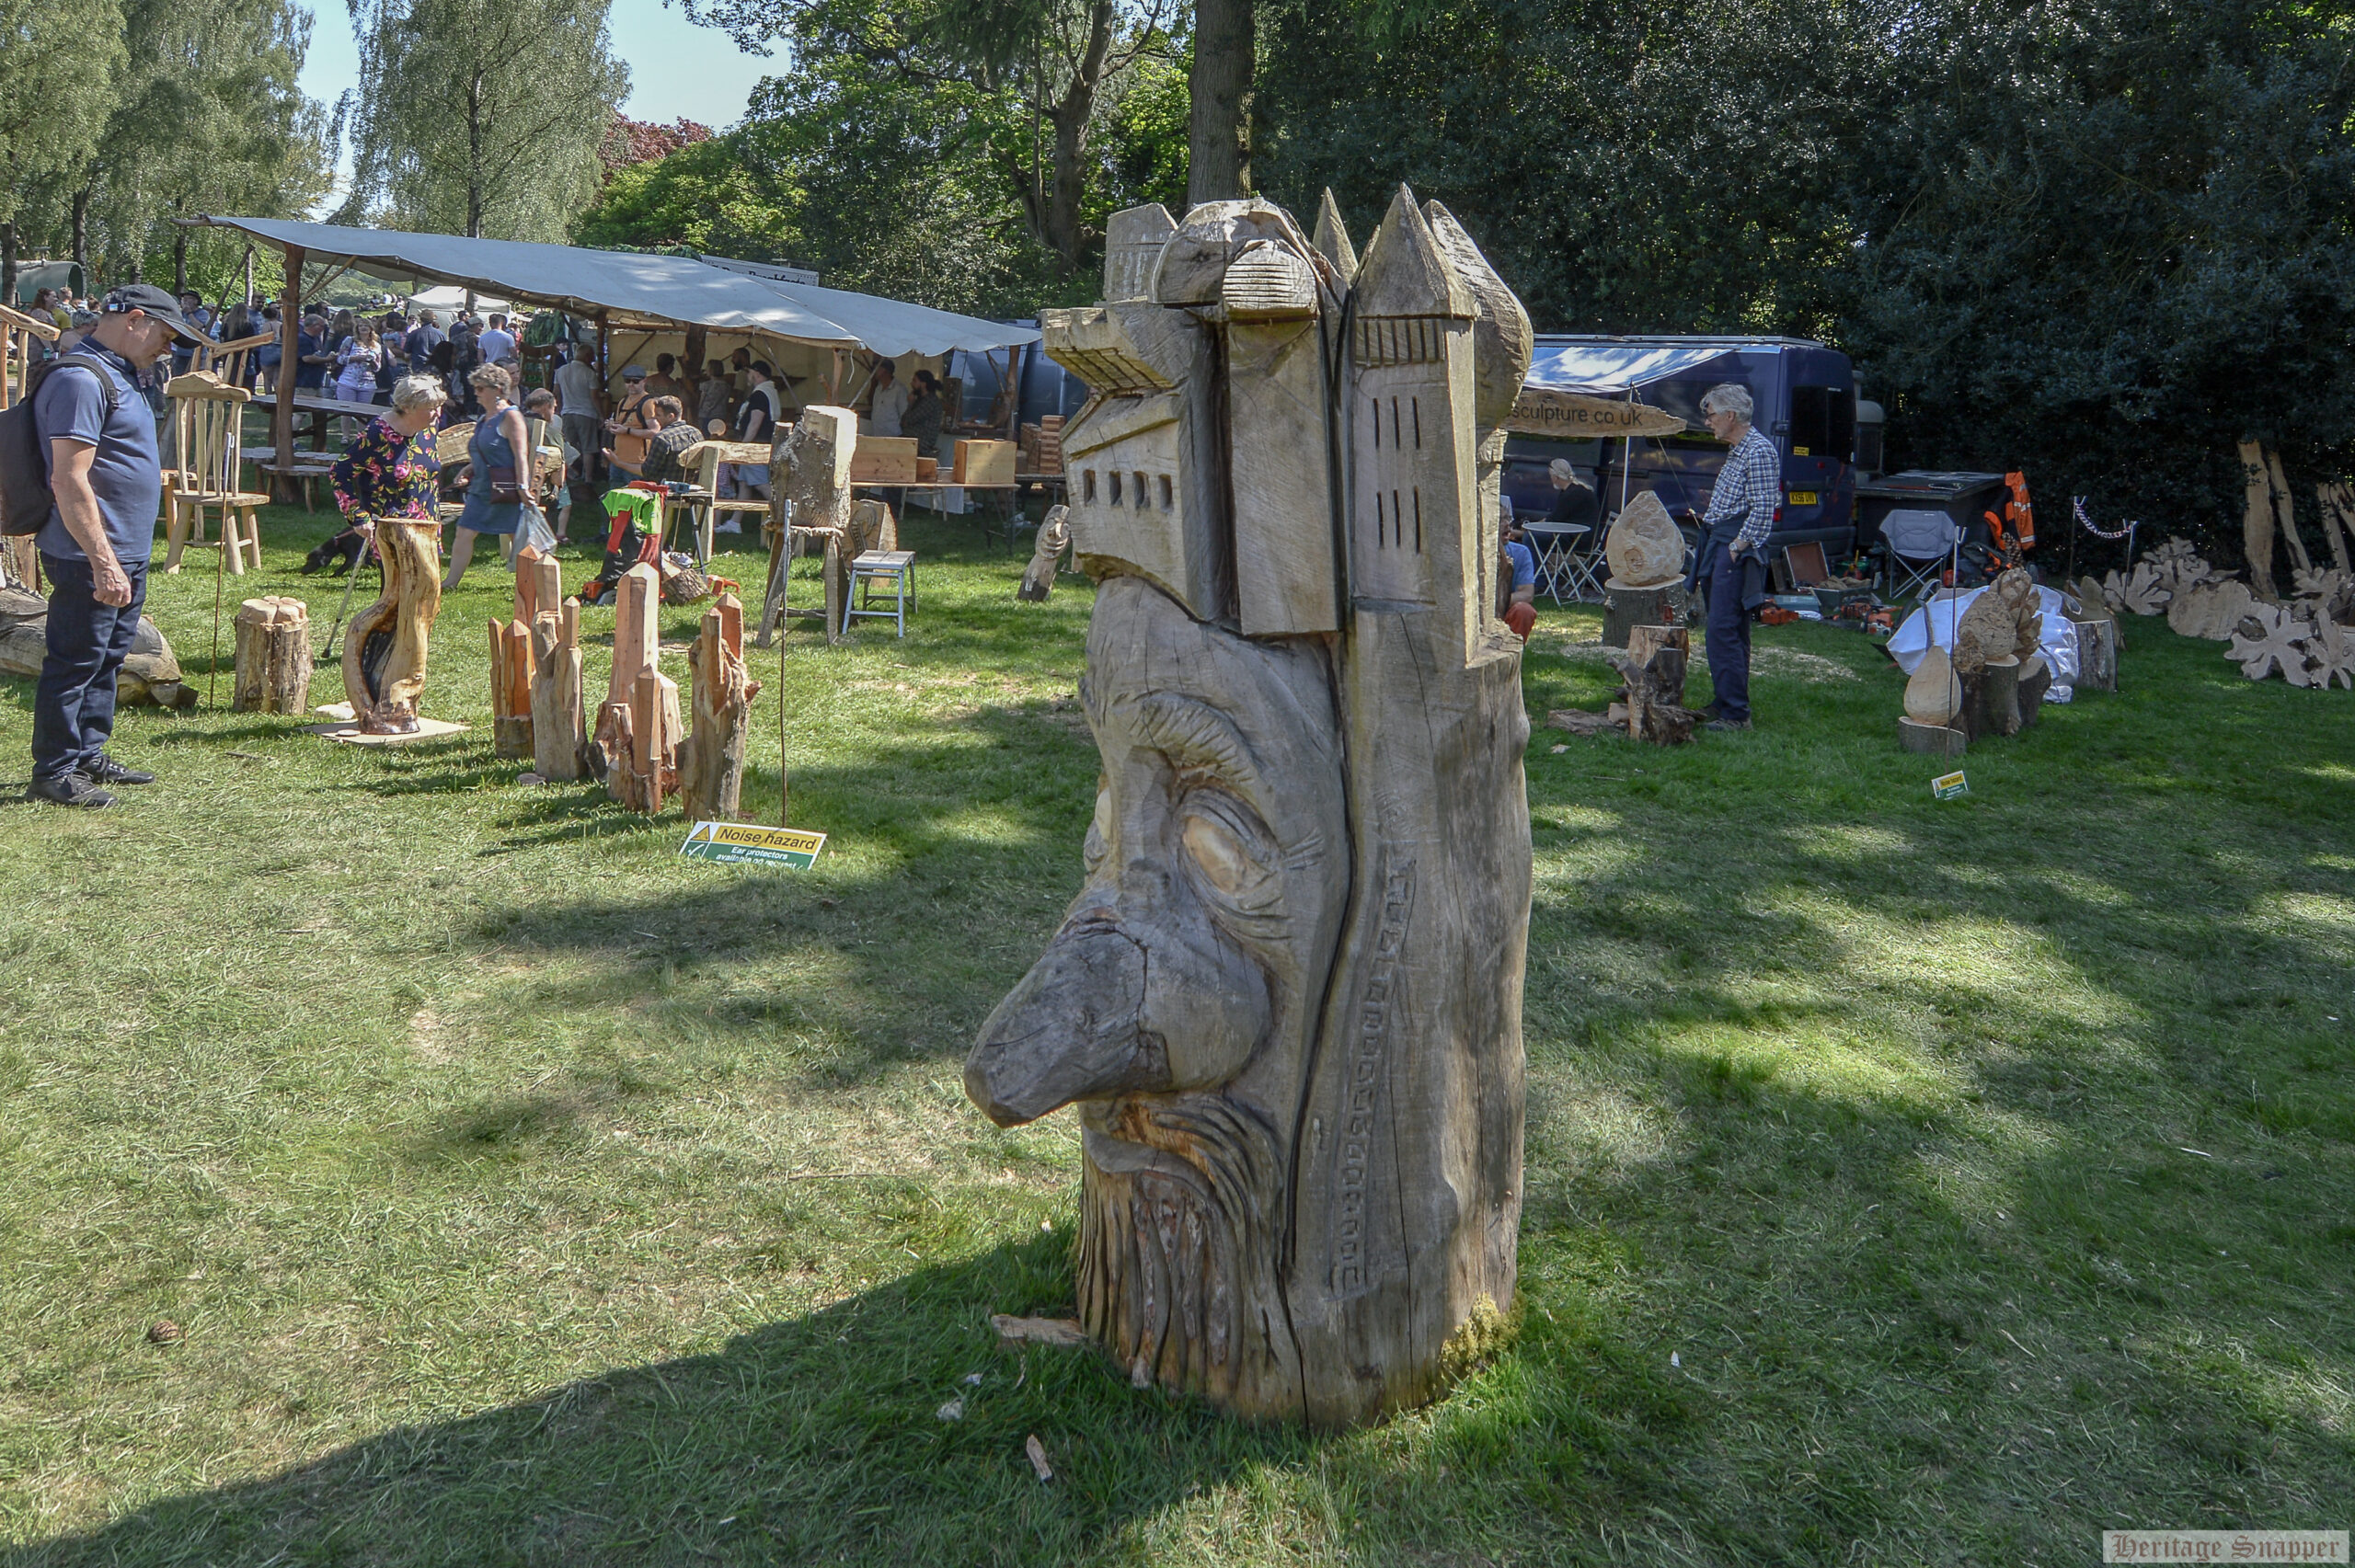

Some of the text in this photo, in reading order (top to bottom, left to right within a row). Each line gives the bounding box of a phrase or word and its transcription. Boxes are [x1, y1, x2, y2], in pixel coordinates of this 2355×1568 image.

[1508, 404, 1643, 427] sculpture.co.uk
[718, 828, 817, 851] Noise hazard
[730, 846, 788, 861] Ear protectors
